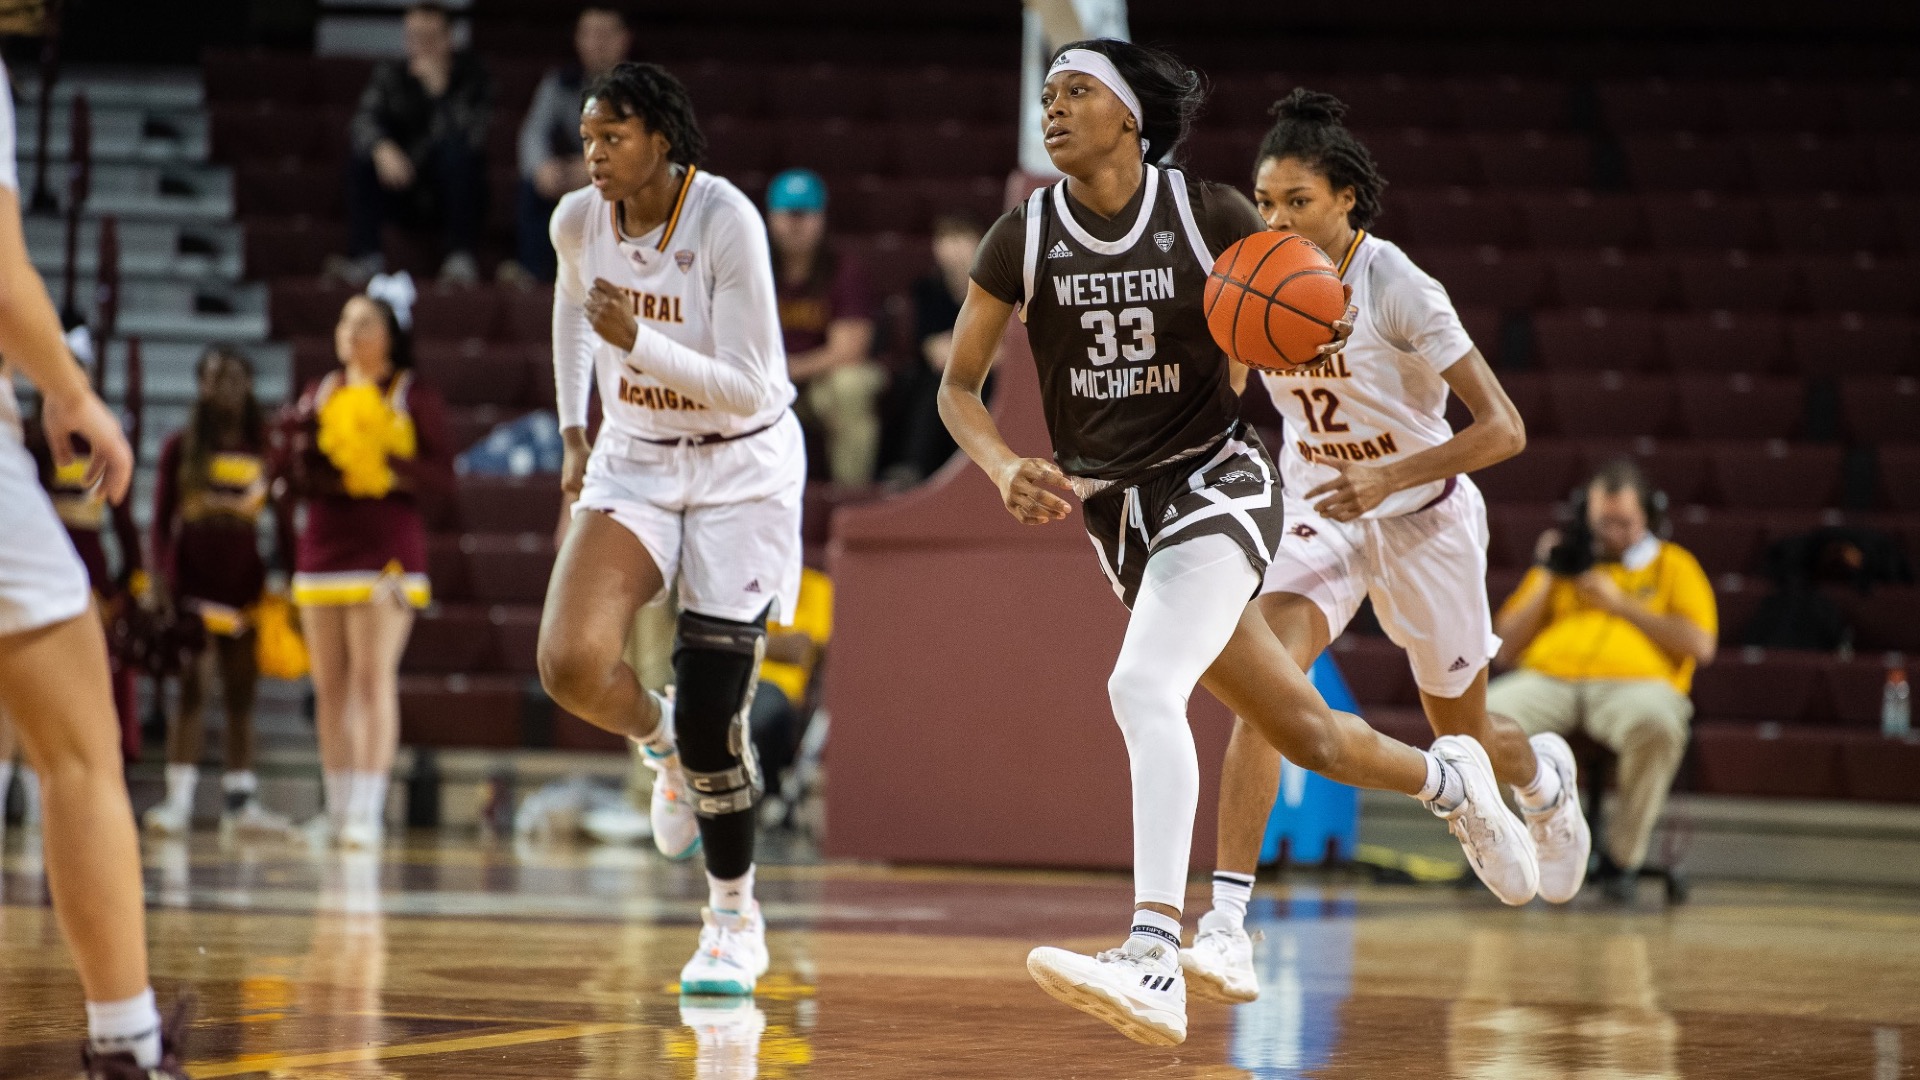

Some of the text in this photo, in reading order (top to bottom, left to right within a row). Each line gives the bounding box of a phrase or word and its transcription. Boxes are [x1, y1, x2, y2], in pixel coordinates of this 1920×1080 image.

[1047, 250, 1074, 259] adidas
[624, 288, 683, 323] TRAL
[1053, 267, 1175, 306] WESTERN
[1080, 307, 1156, 366] 33
[1070, 363, 1180, 400] MICHIGAN
[1291, 388, 1350, 433] 12
